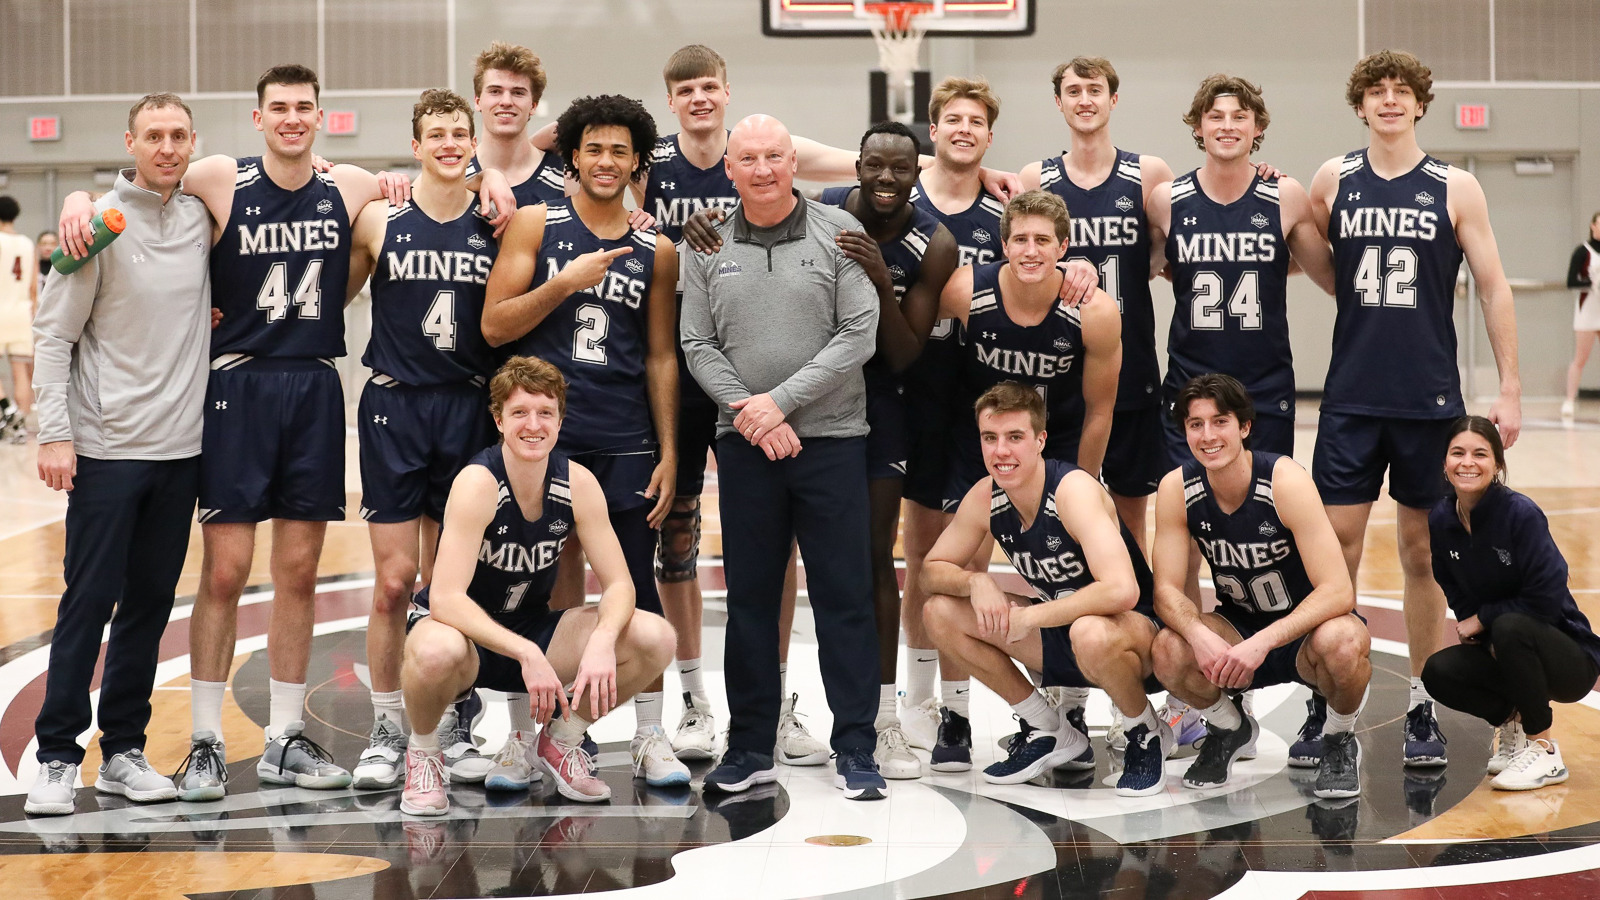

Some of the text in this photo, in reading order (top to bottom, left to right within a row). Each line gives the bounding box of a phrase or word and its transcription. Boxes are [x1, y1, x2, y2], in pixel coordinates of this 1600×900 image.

[238, 219, 339, 255] MINES
[1069, 216, 1139, 248] INES
[1340, 207, 1438, 242] MINES
[1176, 232, 1276, 263] MINES
[12, 256, 22, 281] 4
[386, 250, 492, 285] MINES
[1354, 246, 1418, 309] 42
[257, 259, 323, 324] 44
[1191, 270, 1263, 331] 24
[421, 290, 457, 351] 4
[572, 303, 610, 366] 2
[976, 342, 1075, 378] MINES
[501, 580, 532, 613] 1
[1216, 569, 1293, 614] 20
